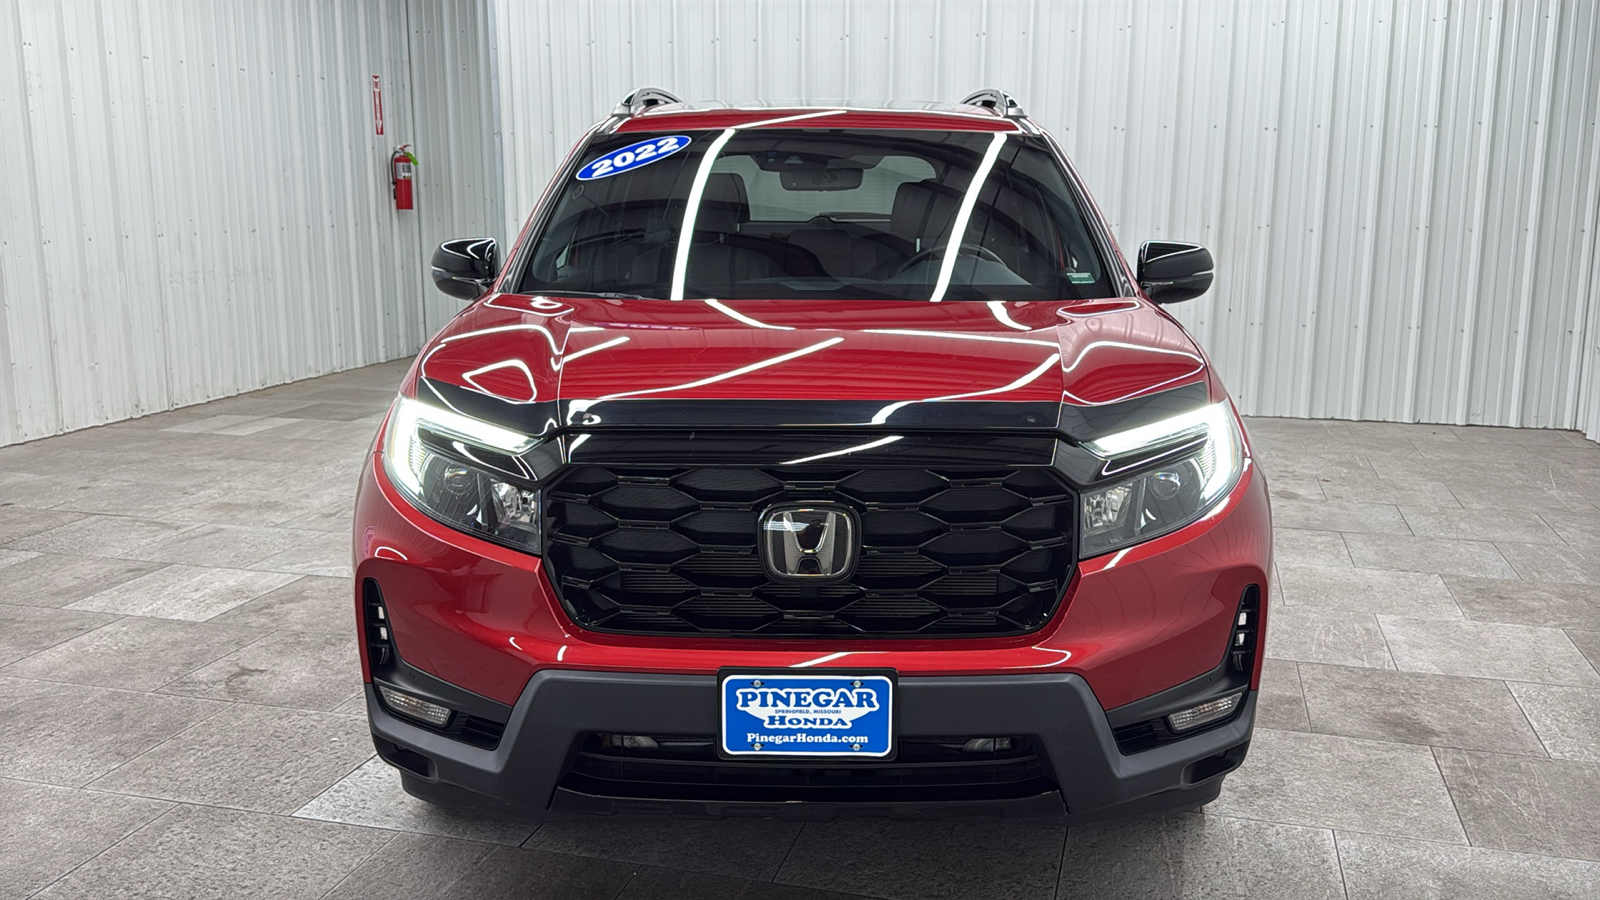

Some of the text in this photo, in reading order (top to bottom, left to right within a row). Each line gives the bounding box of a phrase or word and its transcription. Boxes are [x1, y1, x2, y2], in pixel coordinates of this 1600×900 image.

[591, 137, 680, 178] 2022
[739, 691, 876, 708] PINEGAR
[746, 733, 869, 744] PinegarHonda.com
